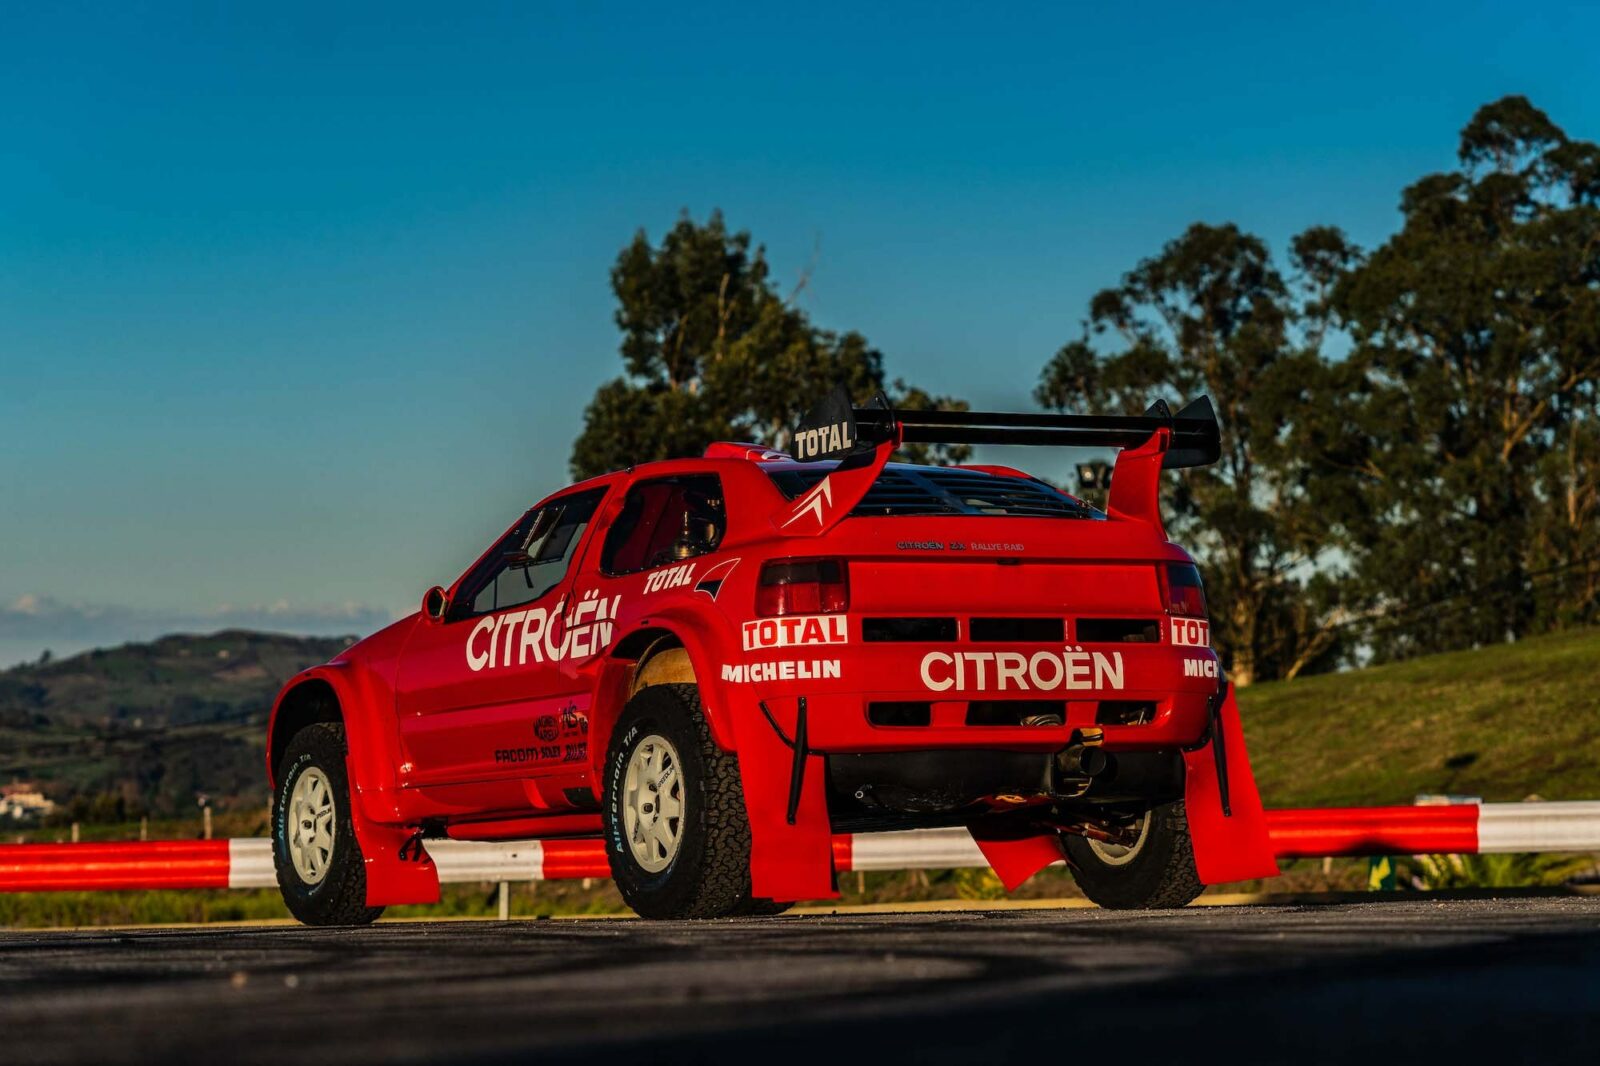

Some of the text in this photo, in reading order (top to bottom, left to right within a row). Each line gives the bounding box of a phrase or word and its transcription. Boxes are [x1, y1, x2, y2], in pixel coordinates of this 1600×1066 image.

[795, 421, 852, 459] TOTAL
[896, 540, 945, 551] CITROËN
[970, 541, 1002, 551] RALLYE
[1003, 543, 1024, 551] RAID
[643, 563, 697, 595] TOTAL
[466, 589, 622, 671] CITROËN
[743, 617, 846, 649] TOTAL
[721, 659, 841, 683] MICHELIN
[920, 645, 1124, 691] CITROËN
[623, 726, 638, 746] T/A
